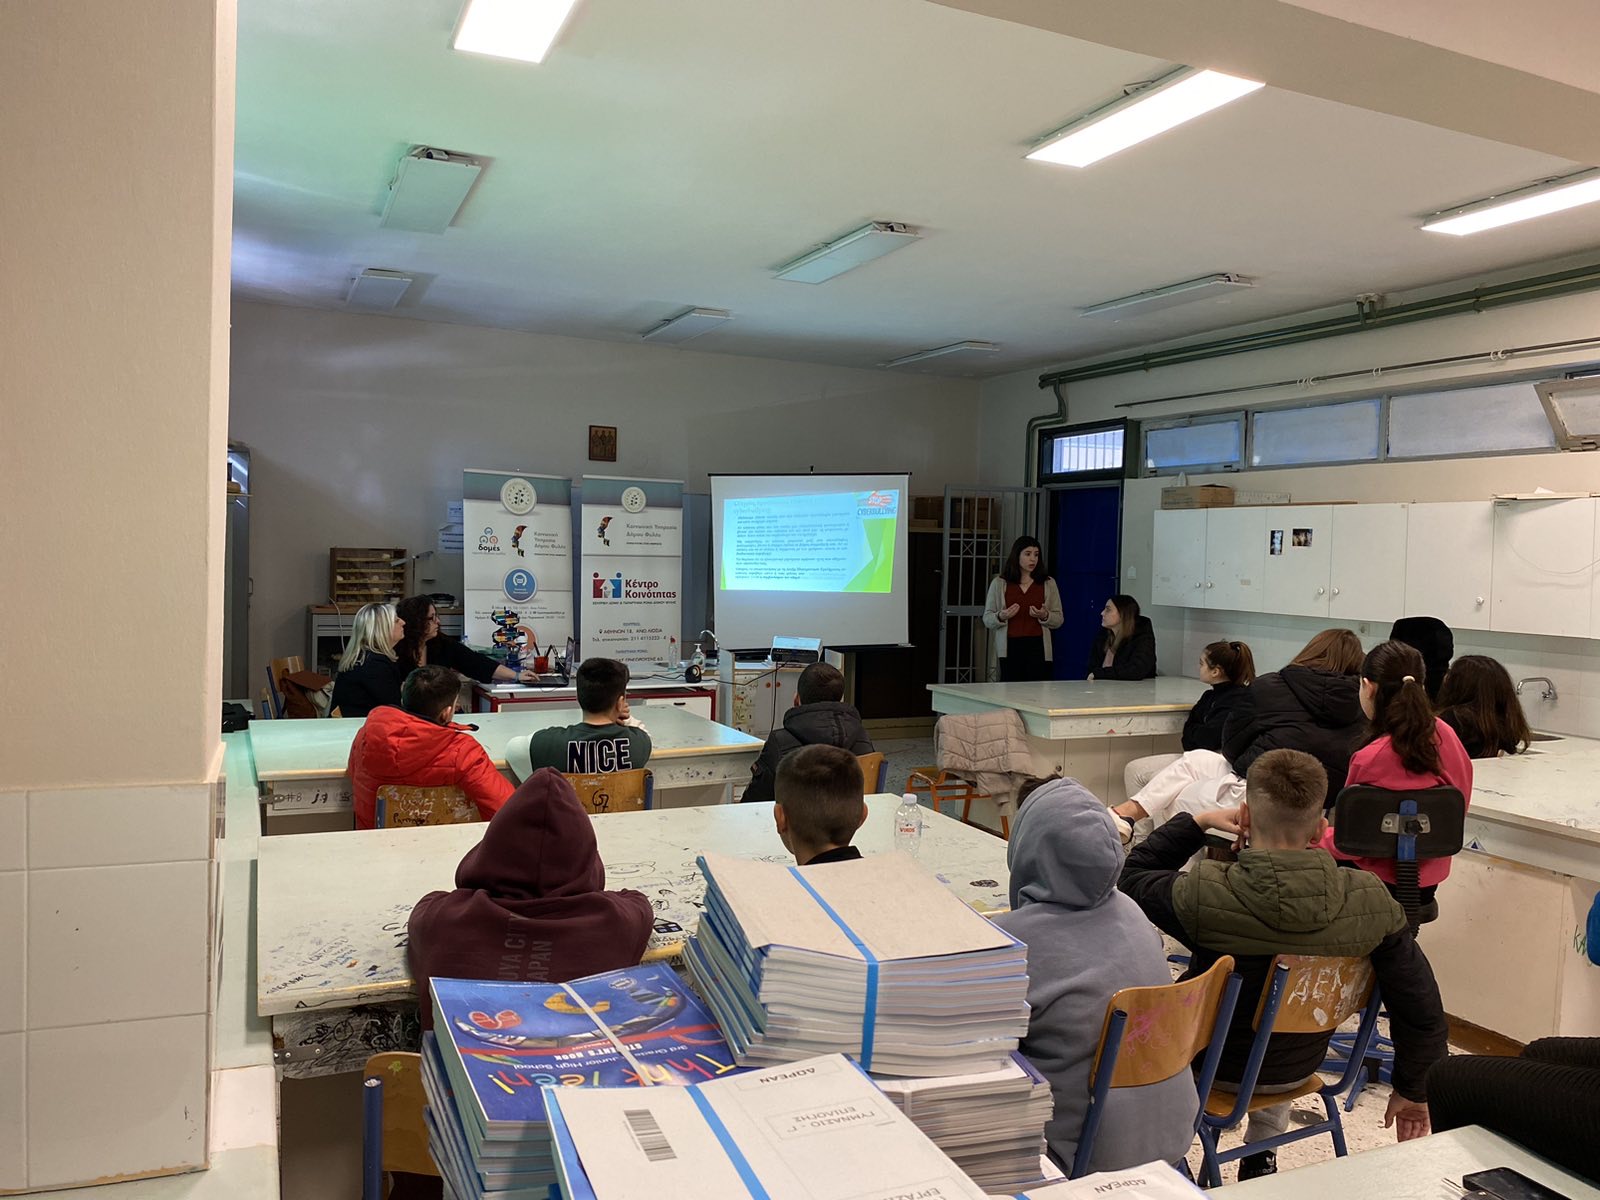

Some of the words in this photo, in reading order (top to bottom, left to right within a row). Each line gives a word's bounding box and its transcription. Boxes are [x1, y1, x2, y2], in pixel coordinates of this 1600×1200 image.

[478, 544, 500, 553] δομές
[625, 579, 659, 590] Κέντρο
[625, 589, 677, 599] Κοινότητας
[567, 737, 632, 775] NICE
[587, 1042, 643, 1057] STUENT'S
[669, 1044, 688, 1053] 3rd
[585, 1056, 619, 1066] Junior
[759, 1067, 816, 1084] ΔΩΡΕΑΝ
[793, 1106, 857, 1123] ΕΠΙΛΟΓΗΣ
[810, 1110, 876, 1128] ΓΥΜΝΑΣΙΟ
[1094, 1178, 1147, 1194] ΔΩΡΕΑΝ
